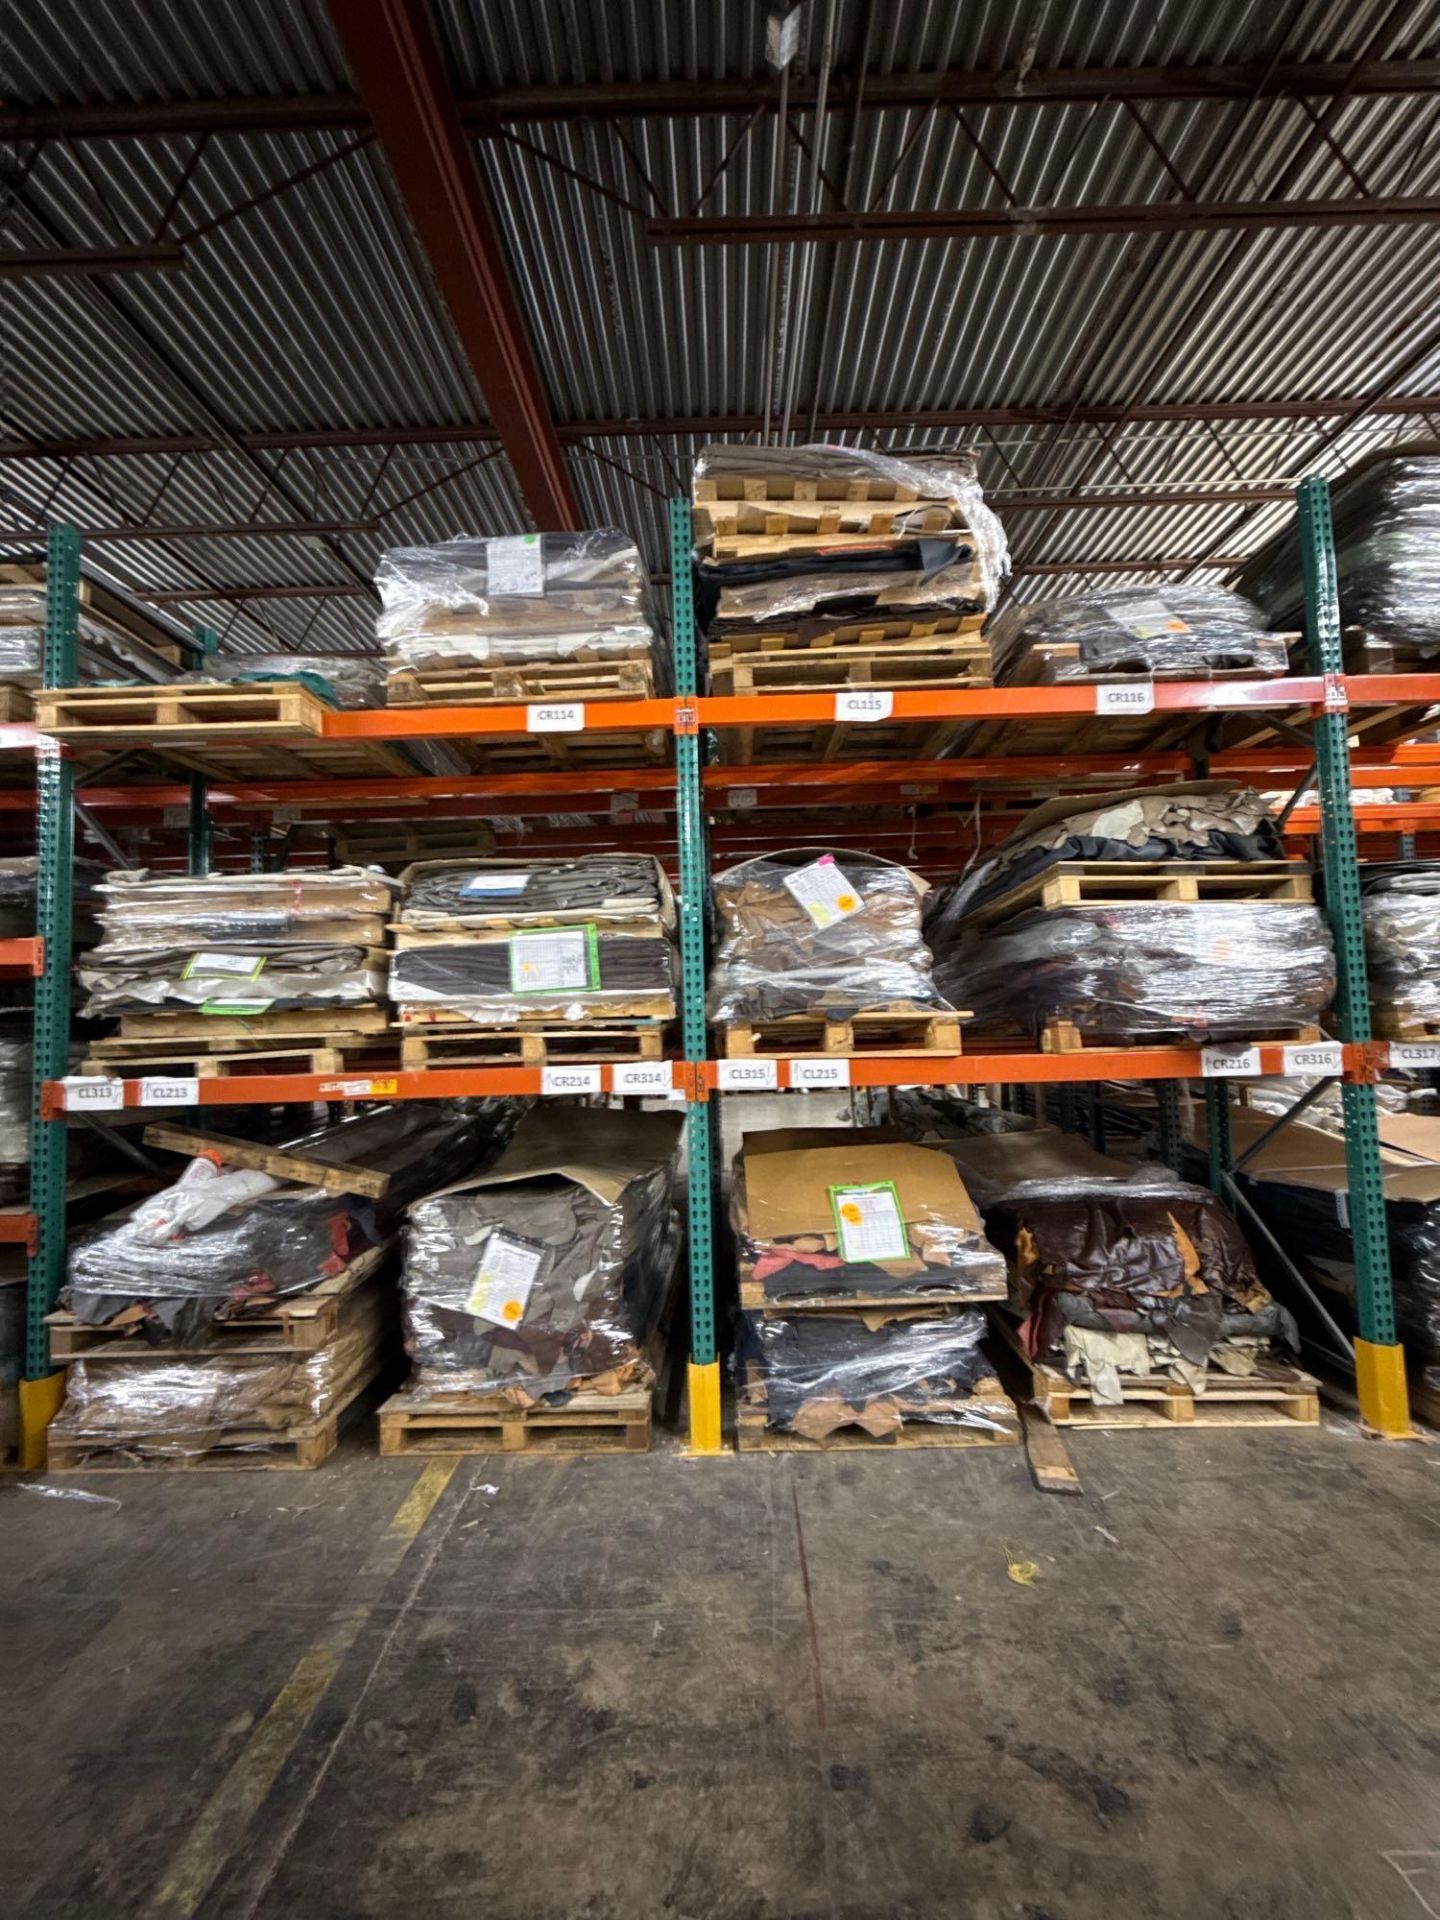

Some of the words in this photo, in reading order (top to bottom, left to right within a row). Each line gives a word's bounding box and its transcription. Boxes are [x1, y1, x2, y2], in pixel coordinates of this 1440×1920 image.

[1107, 692, 1146, 703] CR116
[847, 699, 883, 710] CL115
[537, 709, 575, 720] CR114
[1294, 1053, 1332, 1065] CR316
[1401, 1048, 1436, 1059] CL317
[1212, 1058, 1251, 1069] CR216
[624, 1072, 662, 1084] CR314
[730, 1069, 766, 1079] CL315
[803, 1068, 838, 1079] CL215
[554, 1075, 591, 1087] CR214
[78, 1088, 112, 1098] CL313
[153, 1087, 188, 1098] CL213
